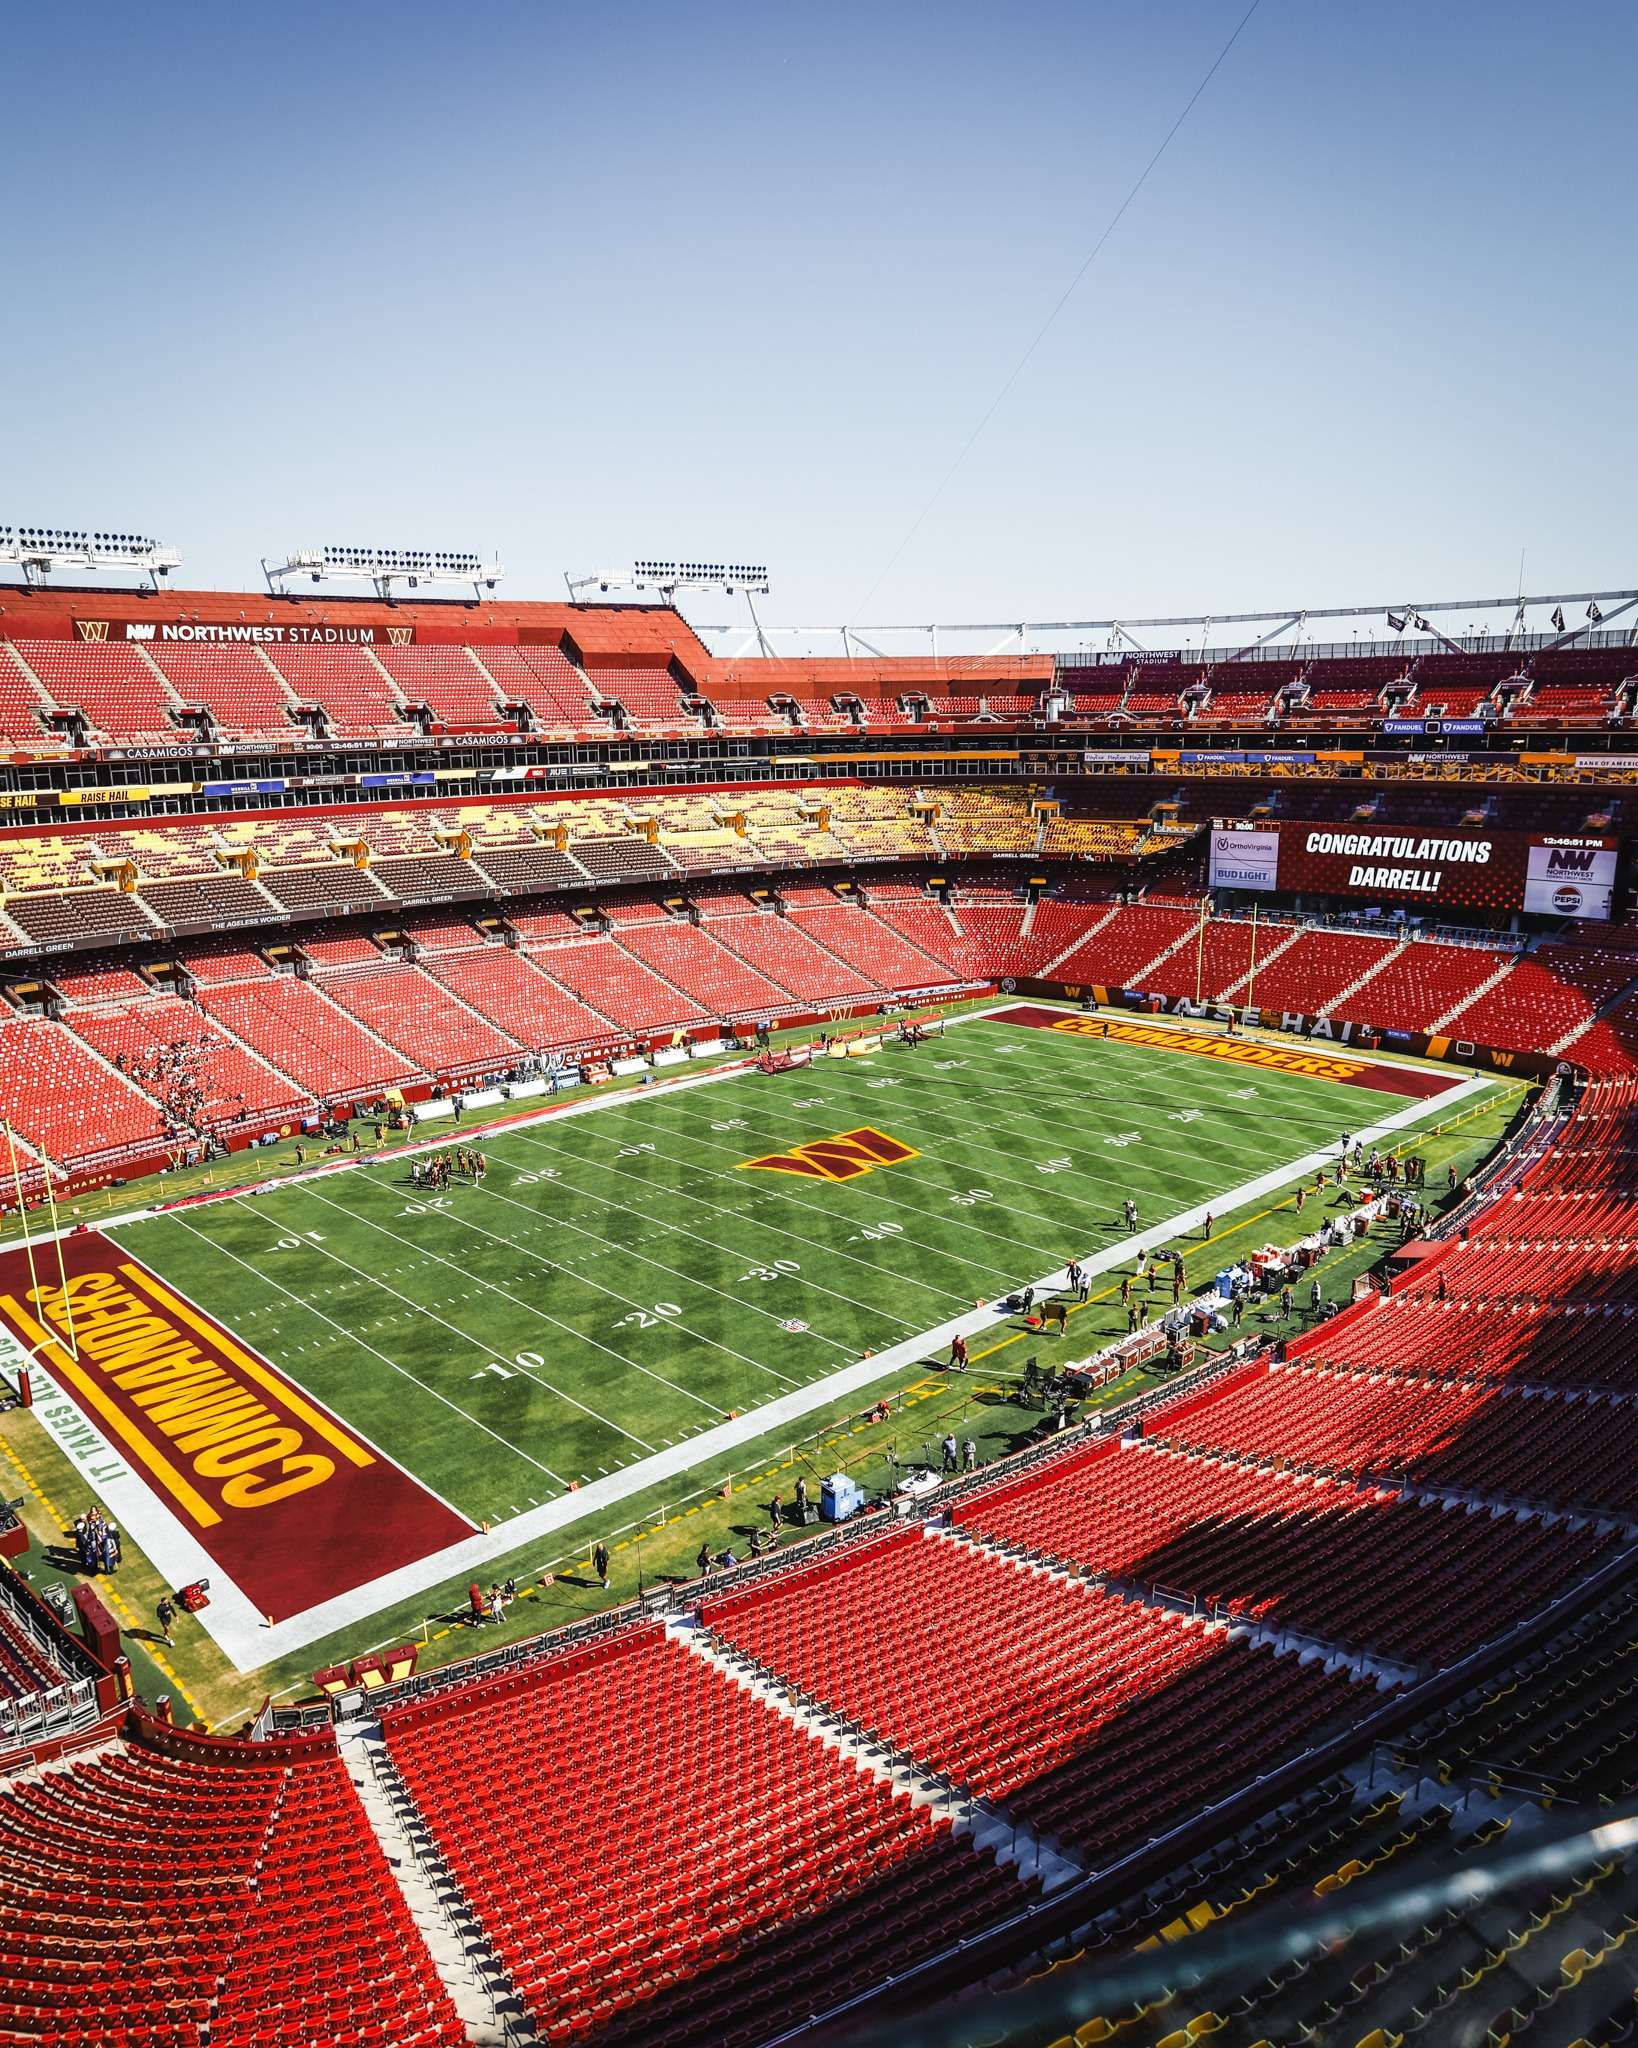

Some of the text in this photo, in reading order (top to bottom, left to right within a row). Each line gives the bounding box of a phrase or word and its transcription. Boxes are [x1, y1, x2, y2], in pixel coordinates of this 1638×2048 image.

[162, 624, 285, 642] NORTHWEST
[289, 627, 374, 643] STADIUM
[1125, 650, 1179, 660] NORTHWEST
[235, 743, 276, 751] NORTHWEST
[399, 737, 435, 745] NORTHWEST
[455, 735, 509, 746] CASAMIGOS
[126, 747, 193, 759] CASAMIGOS
[14, 795, 38, 807] HAIL
[80, 790, 129, 803] RAISE HAIL
[1229, 841, 1272, 852] OrthoVirginia
[1305, 832, 1493, 864] CONGRATULATIONS
[1542, 836, 1603, 848] 12:46:51 PM
[1547, 849, 1597, 872] NW
[711, 865, 754, 875] DARRELL GREEN
[1217, 869, 1268, 881] BUD LIGHT
[1546, 868, 1595, 878] NORTHWEST
[570, 879, 595, 888] AGELESS
[595, 877, 621, 885] WONDER
[1348, 865, 1442, 892] DARRELL!
[402, 895, 453, 906] DARRELL GREEN
[1554, 895, 1581, 905] PEPSI
[211, 914, 291, 930] THE AGELESS WONDER
[5, 942, 74, 958] DARRELL GREEN
[1051, 1017, 1366, 1080] COMMANDERS
[1168, 1109, 1204, 1123] 20
[1103, 1132, 1142, 1147] 30
[1035, 1158, 1073, 1174] 40
[517, 1168, 562, 1184] 30
[15, 1173, 112, 1206] WORLD CHAMPS
[948, 1188, 994, 1206] 50
[404, 1197, 453, 1215] 20
[860, 1221, 904, 1241] 40
[277, 1230, 327, 1249] 10
[748, 1259, 801, 1281] 30
[625, 1302, 683, 1329] 20
[483, 1351, 545, 1380] 10
[25, 1271, 336, 1509] COMMANDERS
[32, 1374, 63, 1403] ALL
[44, 1404, 106, 1461] TAKES
[88, 1462, 128, 1484] IT
